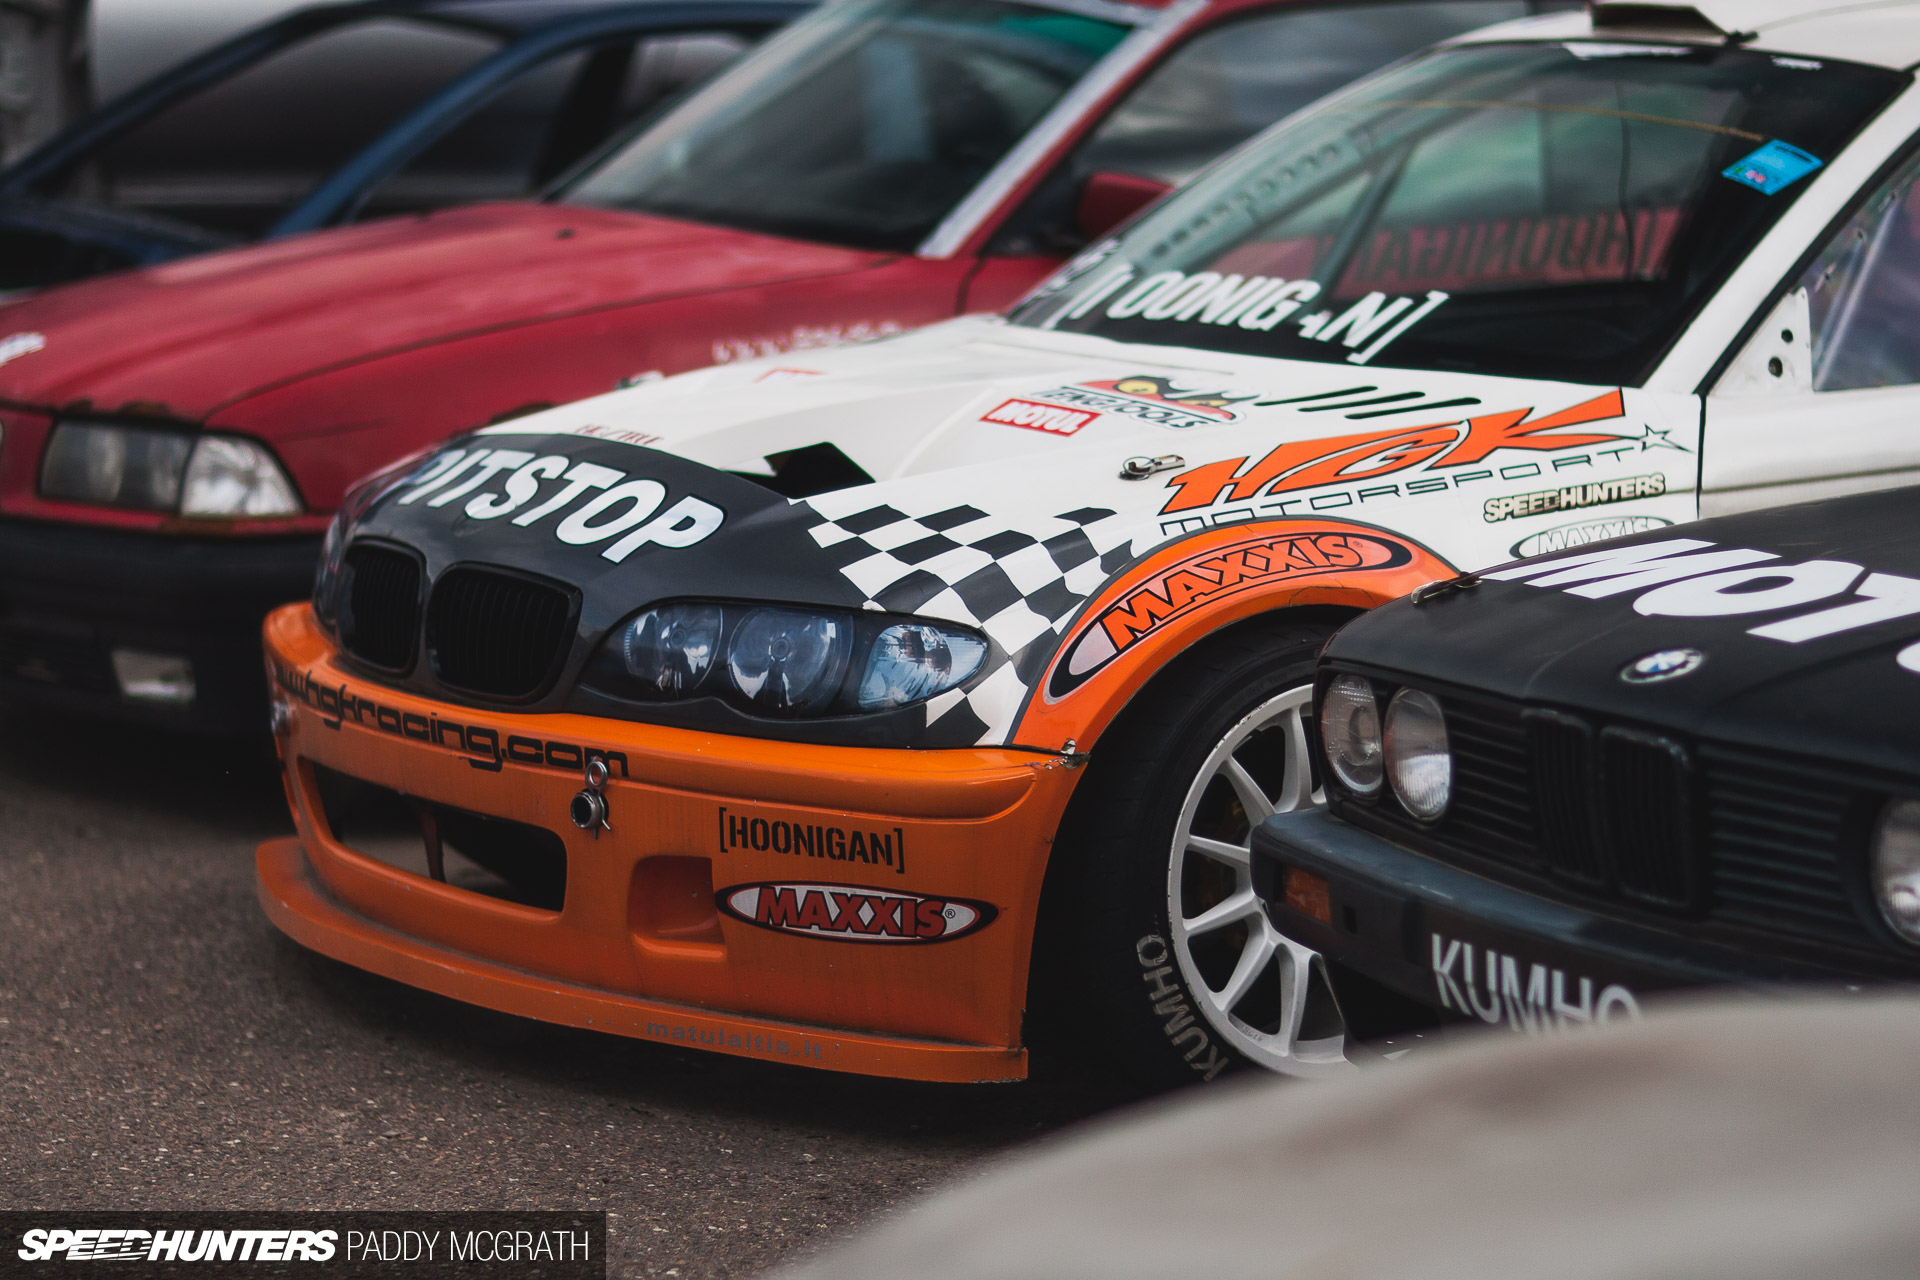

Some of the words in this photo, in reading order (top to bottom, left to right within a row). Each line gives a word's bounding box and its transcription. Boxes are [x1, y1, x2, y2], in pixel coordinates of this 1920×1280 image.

[985, 401, 1093, 433] MOTUL
[1157, 386, 1628, 517] HGK
[370, 448, 725, 564] PITSTOP
[1160, 446, 1636, 536] MOTORSPORT
[1483, 472, 1667, 524] SPEEDHUNTERS
[1100, 534, 1364, 652] MAXXIS
[718, 806, 906, 874] [HOONIGAN]
[756, 884, 949, 939] MAXXIS
[646, 1019, 823, 1061] matulaitis.lt
[1136, 934, 1230, 1082] KUMHO
